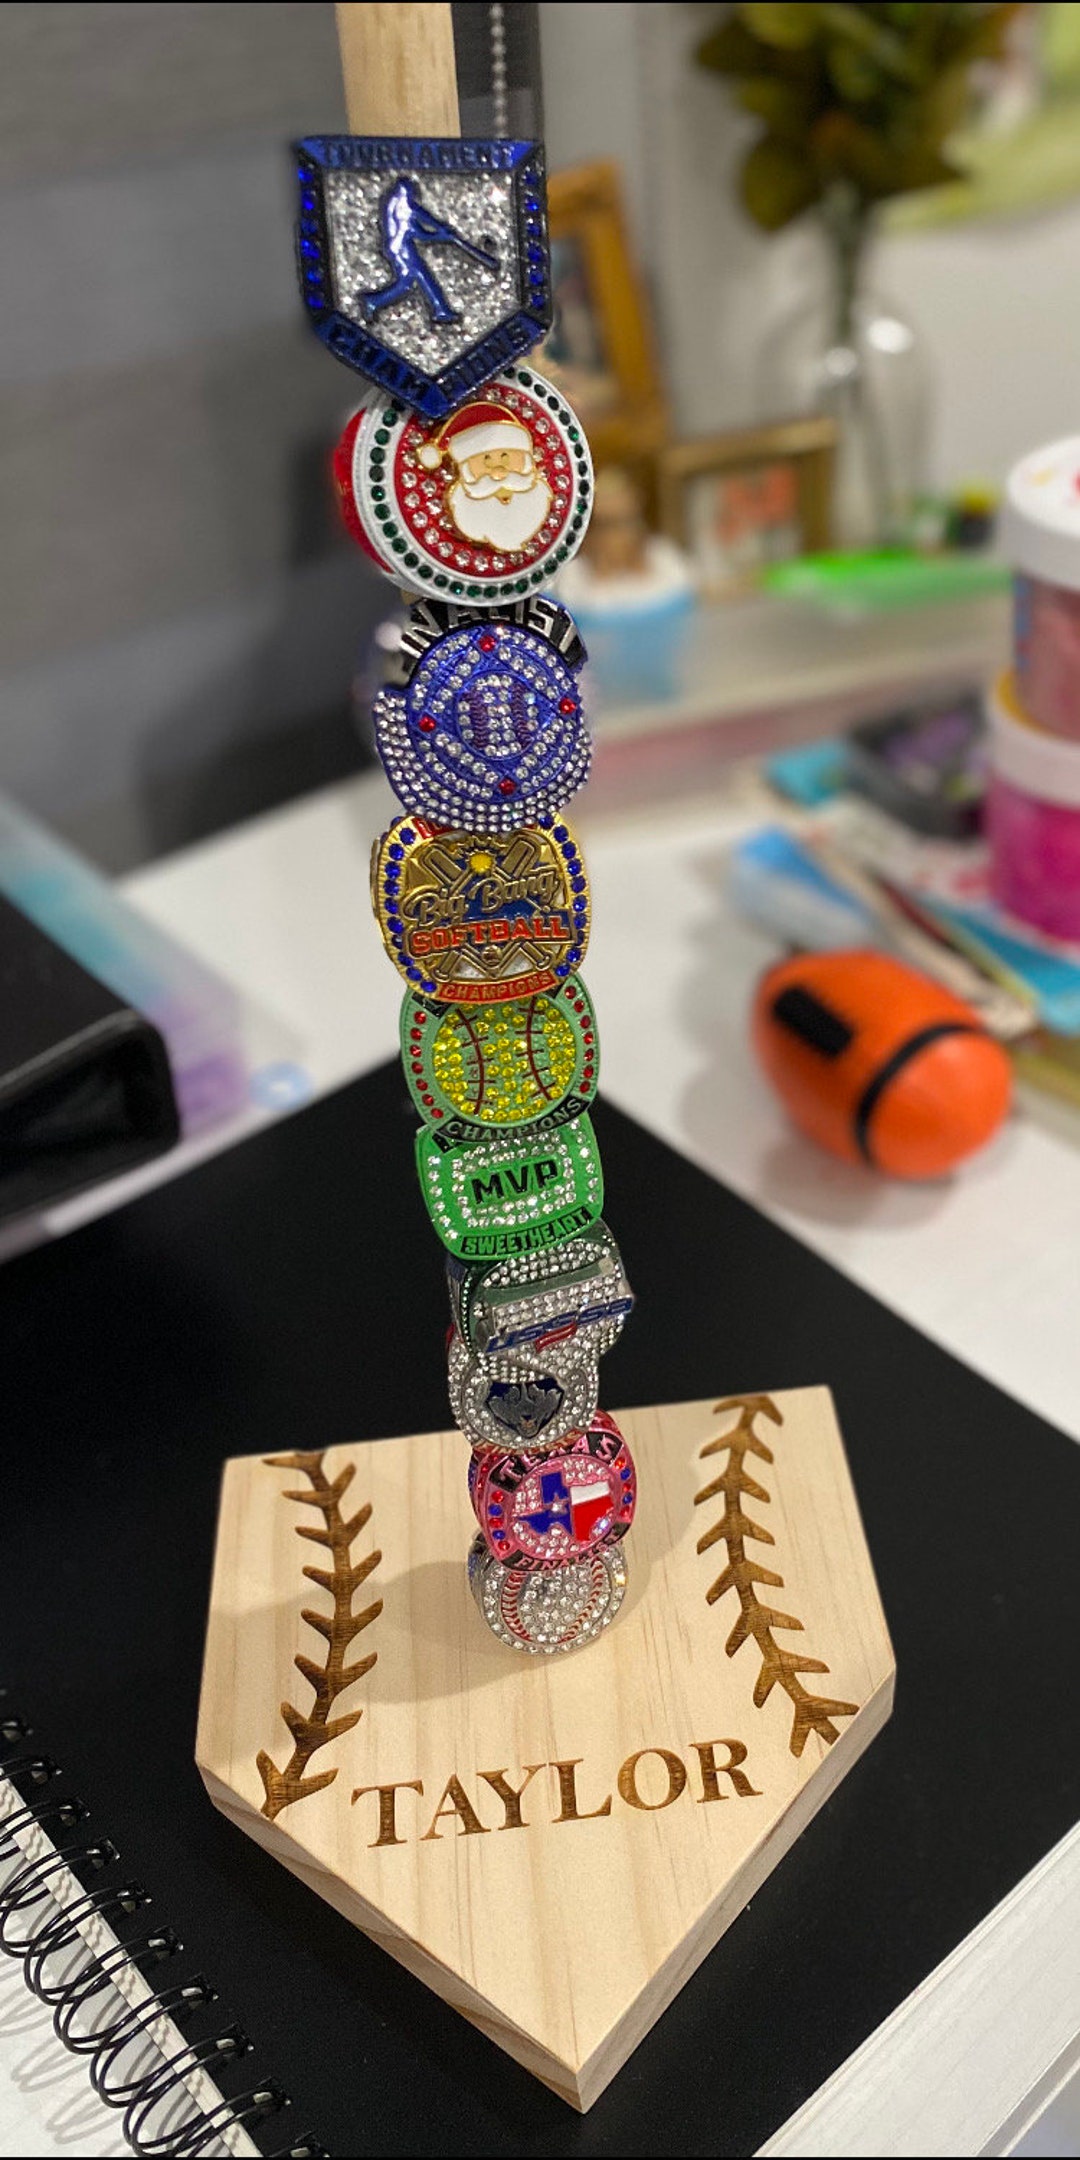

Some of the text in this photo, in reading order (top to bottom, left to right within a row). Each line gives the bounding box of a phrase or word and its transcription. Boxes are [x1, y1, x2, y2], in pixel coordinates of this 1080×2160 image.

[326, 142, 513, 170] TOURNAMENT
[402, 866, 564, 927] Big Bang
[411, 917, 569, 954] SOFTBALL
[443, 973, 551, 1000] CHAMPIONS
[446, 1098, 582, 1140] CHAMPIONS
[471, 1160, 558, 1204] MVP
[465, 1209, 589, 1254] SWEETHEART
[350, 1737, 764, 1849] TAYLOR
